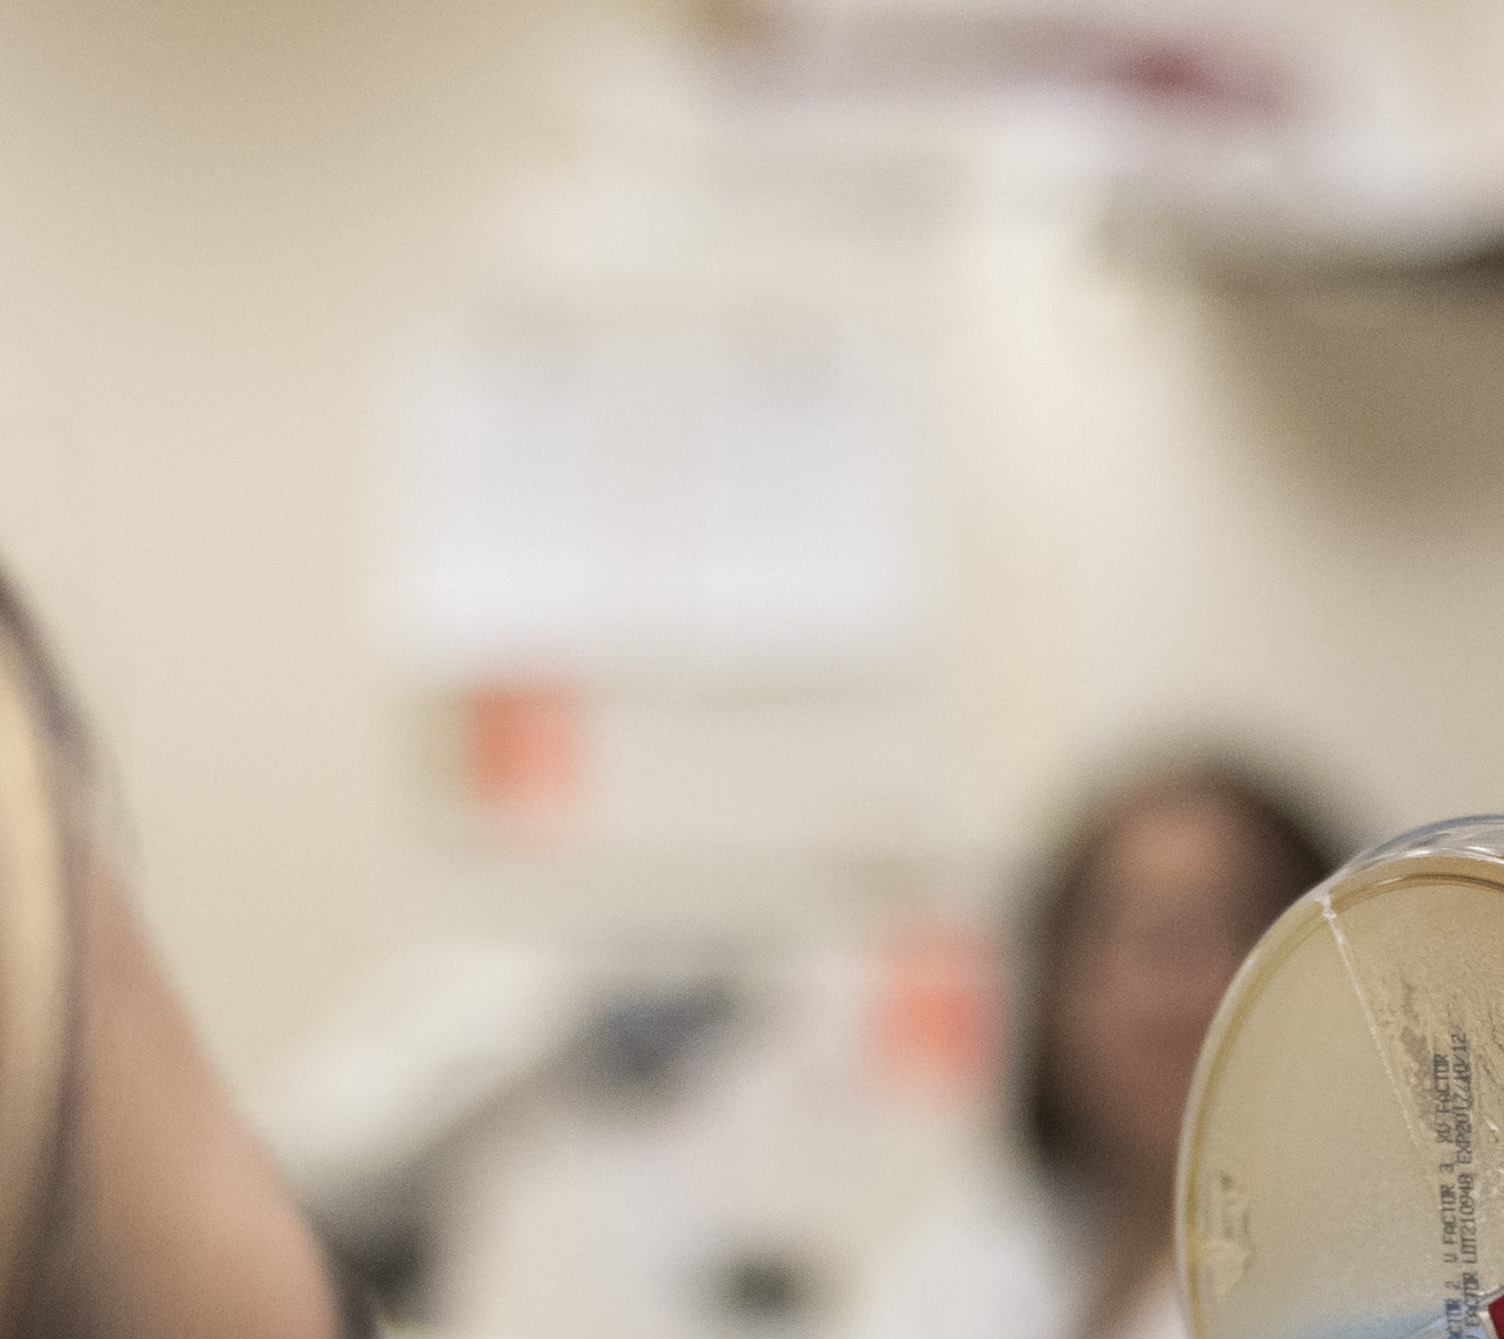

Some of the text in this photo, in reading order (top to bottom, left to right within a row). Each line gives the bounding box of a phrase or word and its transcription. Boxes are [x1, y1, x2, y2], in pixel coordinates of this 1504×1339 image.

[1432, 1052, 1450, 1114] FACTOR
[1439, 1183, 1458, 1245] FACTOR
[1462, 1272, 1481, 1328] FACTOR
